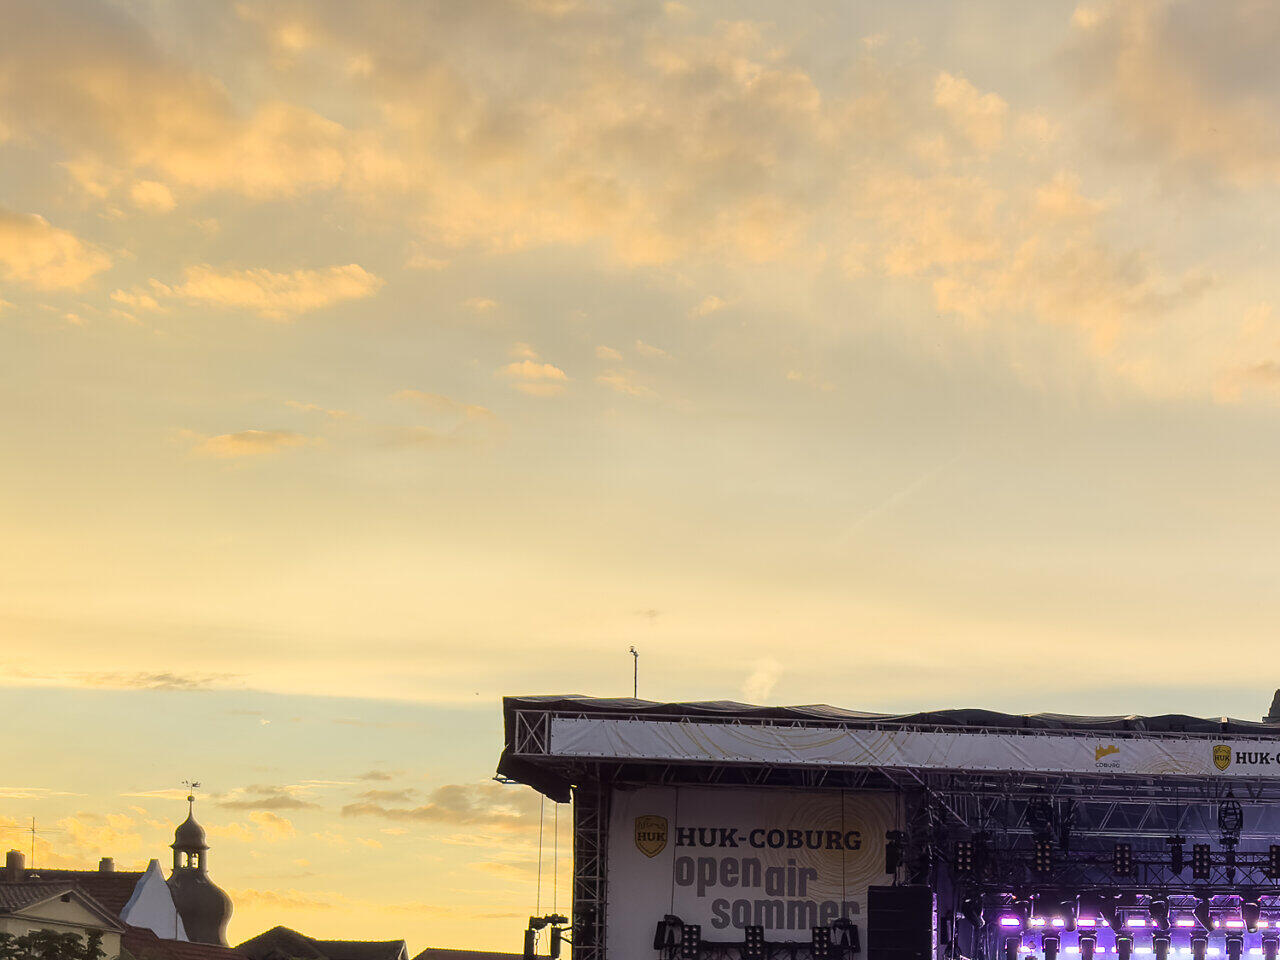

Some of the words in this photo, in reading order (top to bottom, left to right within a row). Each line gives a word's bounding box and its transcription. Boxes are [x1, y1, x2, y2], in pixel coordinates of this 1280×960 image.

[637, 832, 665, 841] HUK
[675, 827, 862, 850] HUK-COBURG
[675, 856, 762, 897] open
[765, 858, 818, 897] air
[710, 899, 861, 930] sommer
